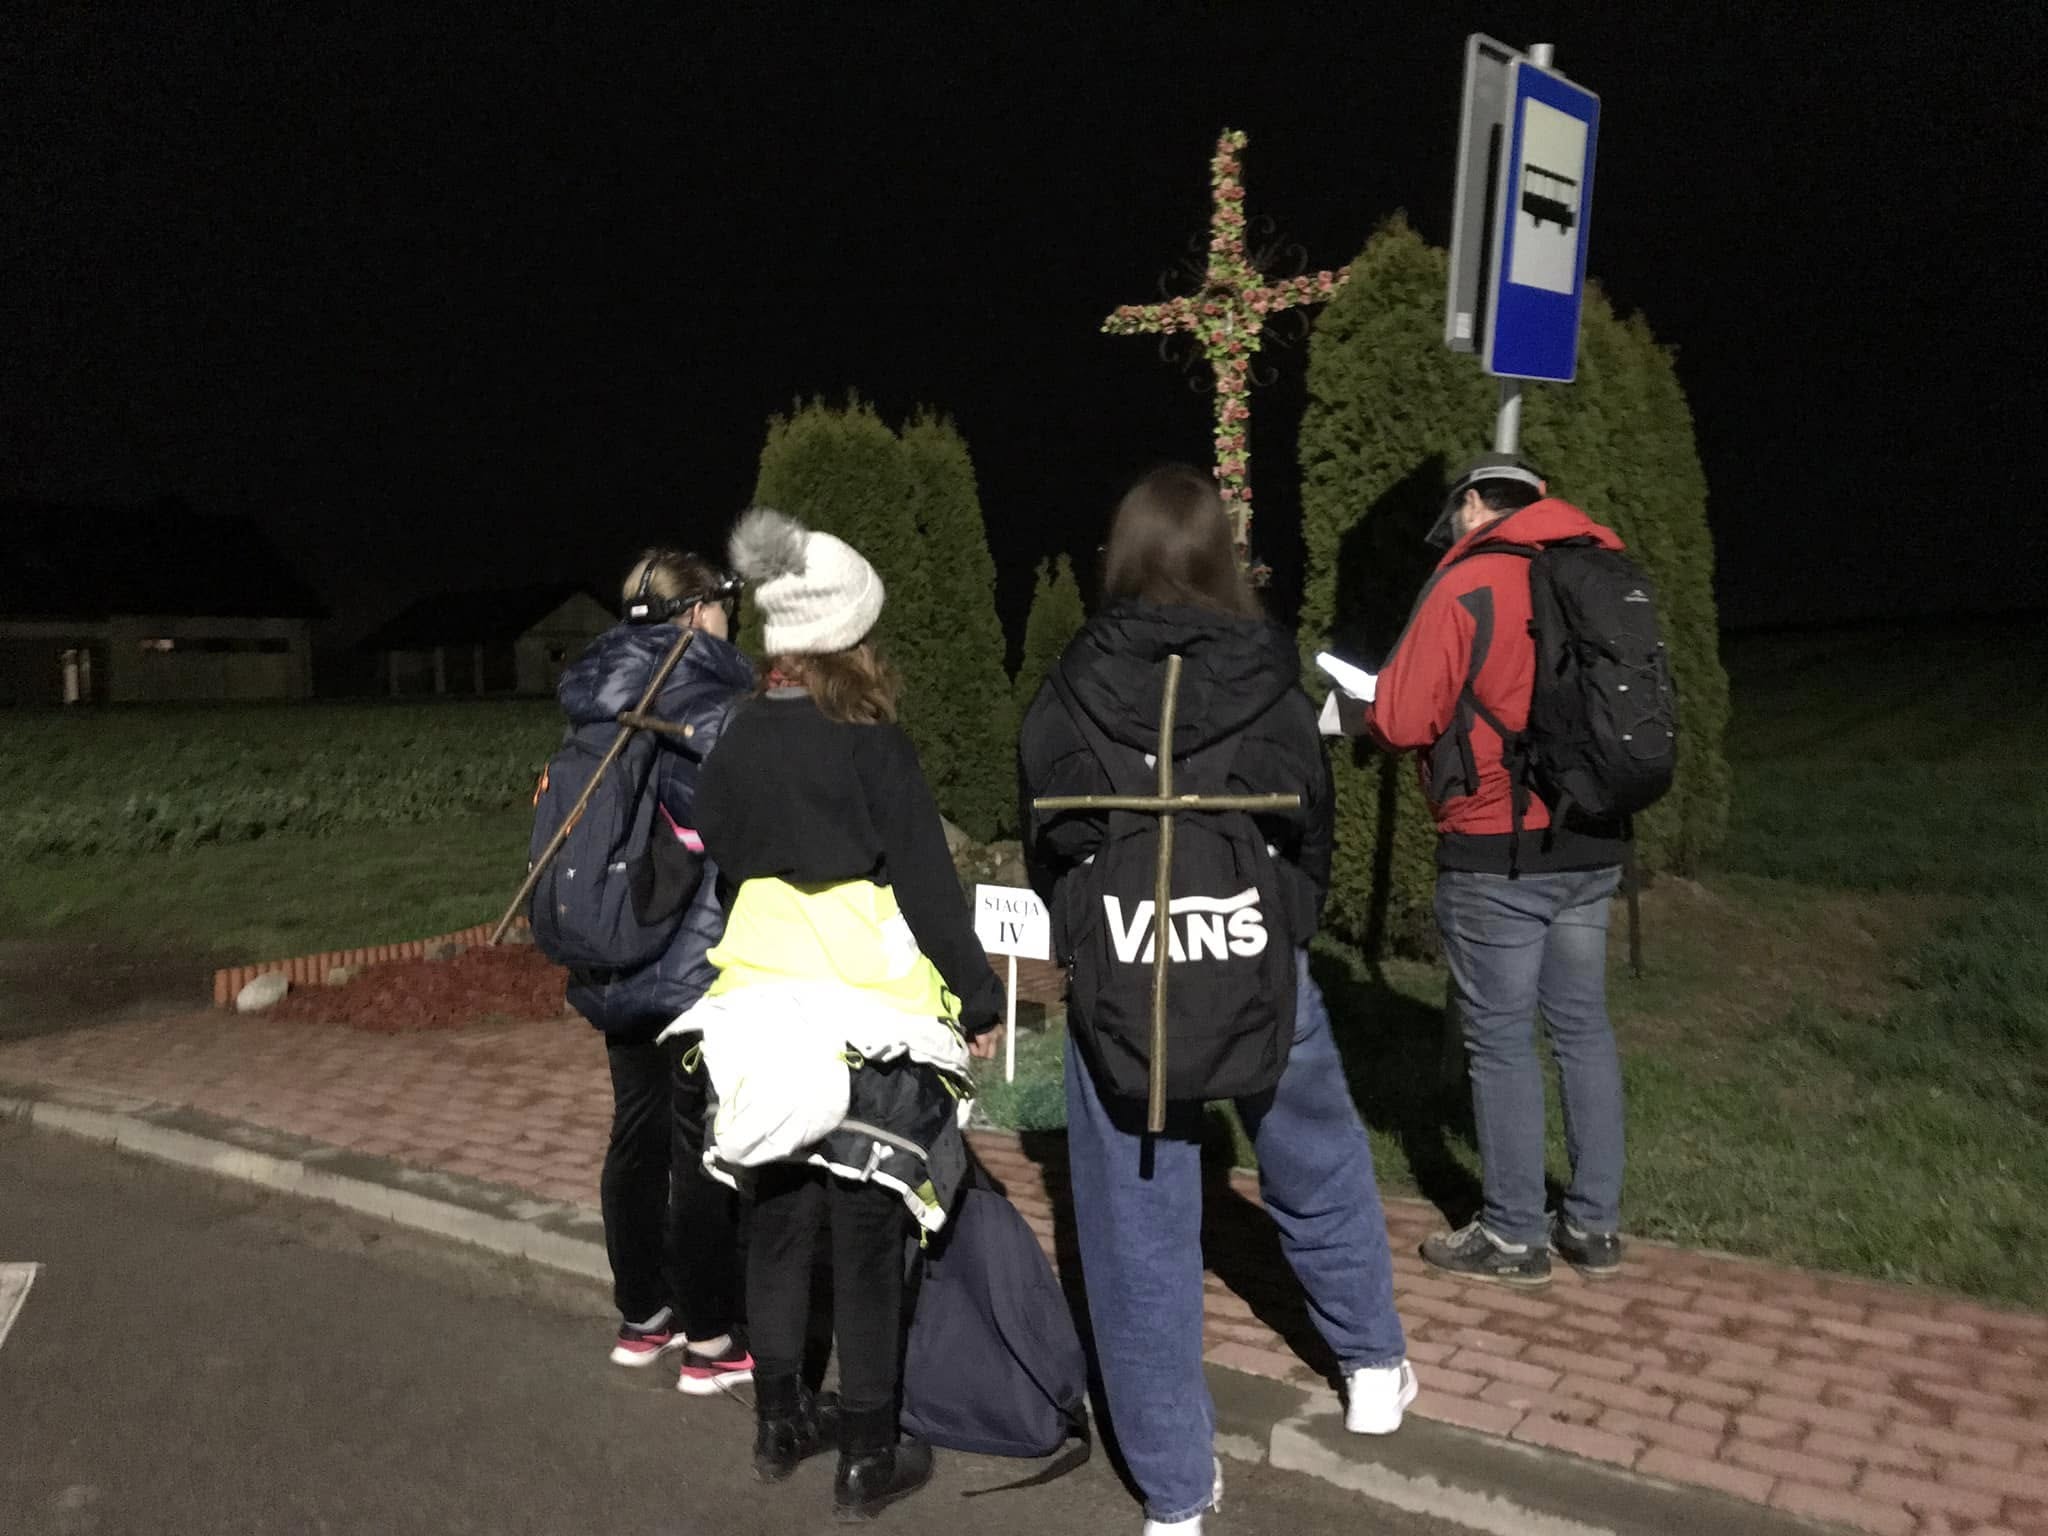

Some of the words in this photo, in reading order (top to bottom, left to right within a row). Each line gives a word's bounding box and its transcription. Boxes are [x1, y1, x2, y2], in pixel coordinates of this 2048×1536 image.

[984, 896, 1039, 917] STACJA
[1000, 920, 1025, 945] IV
[1103, 886, 1268, 964] VANS
